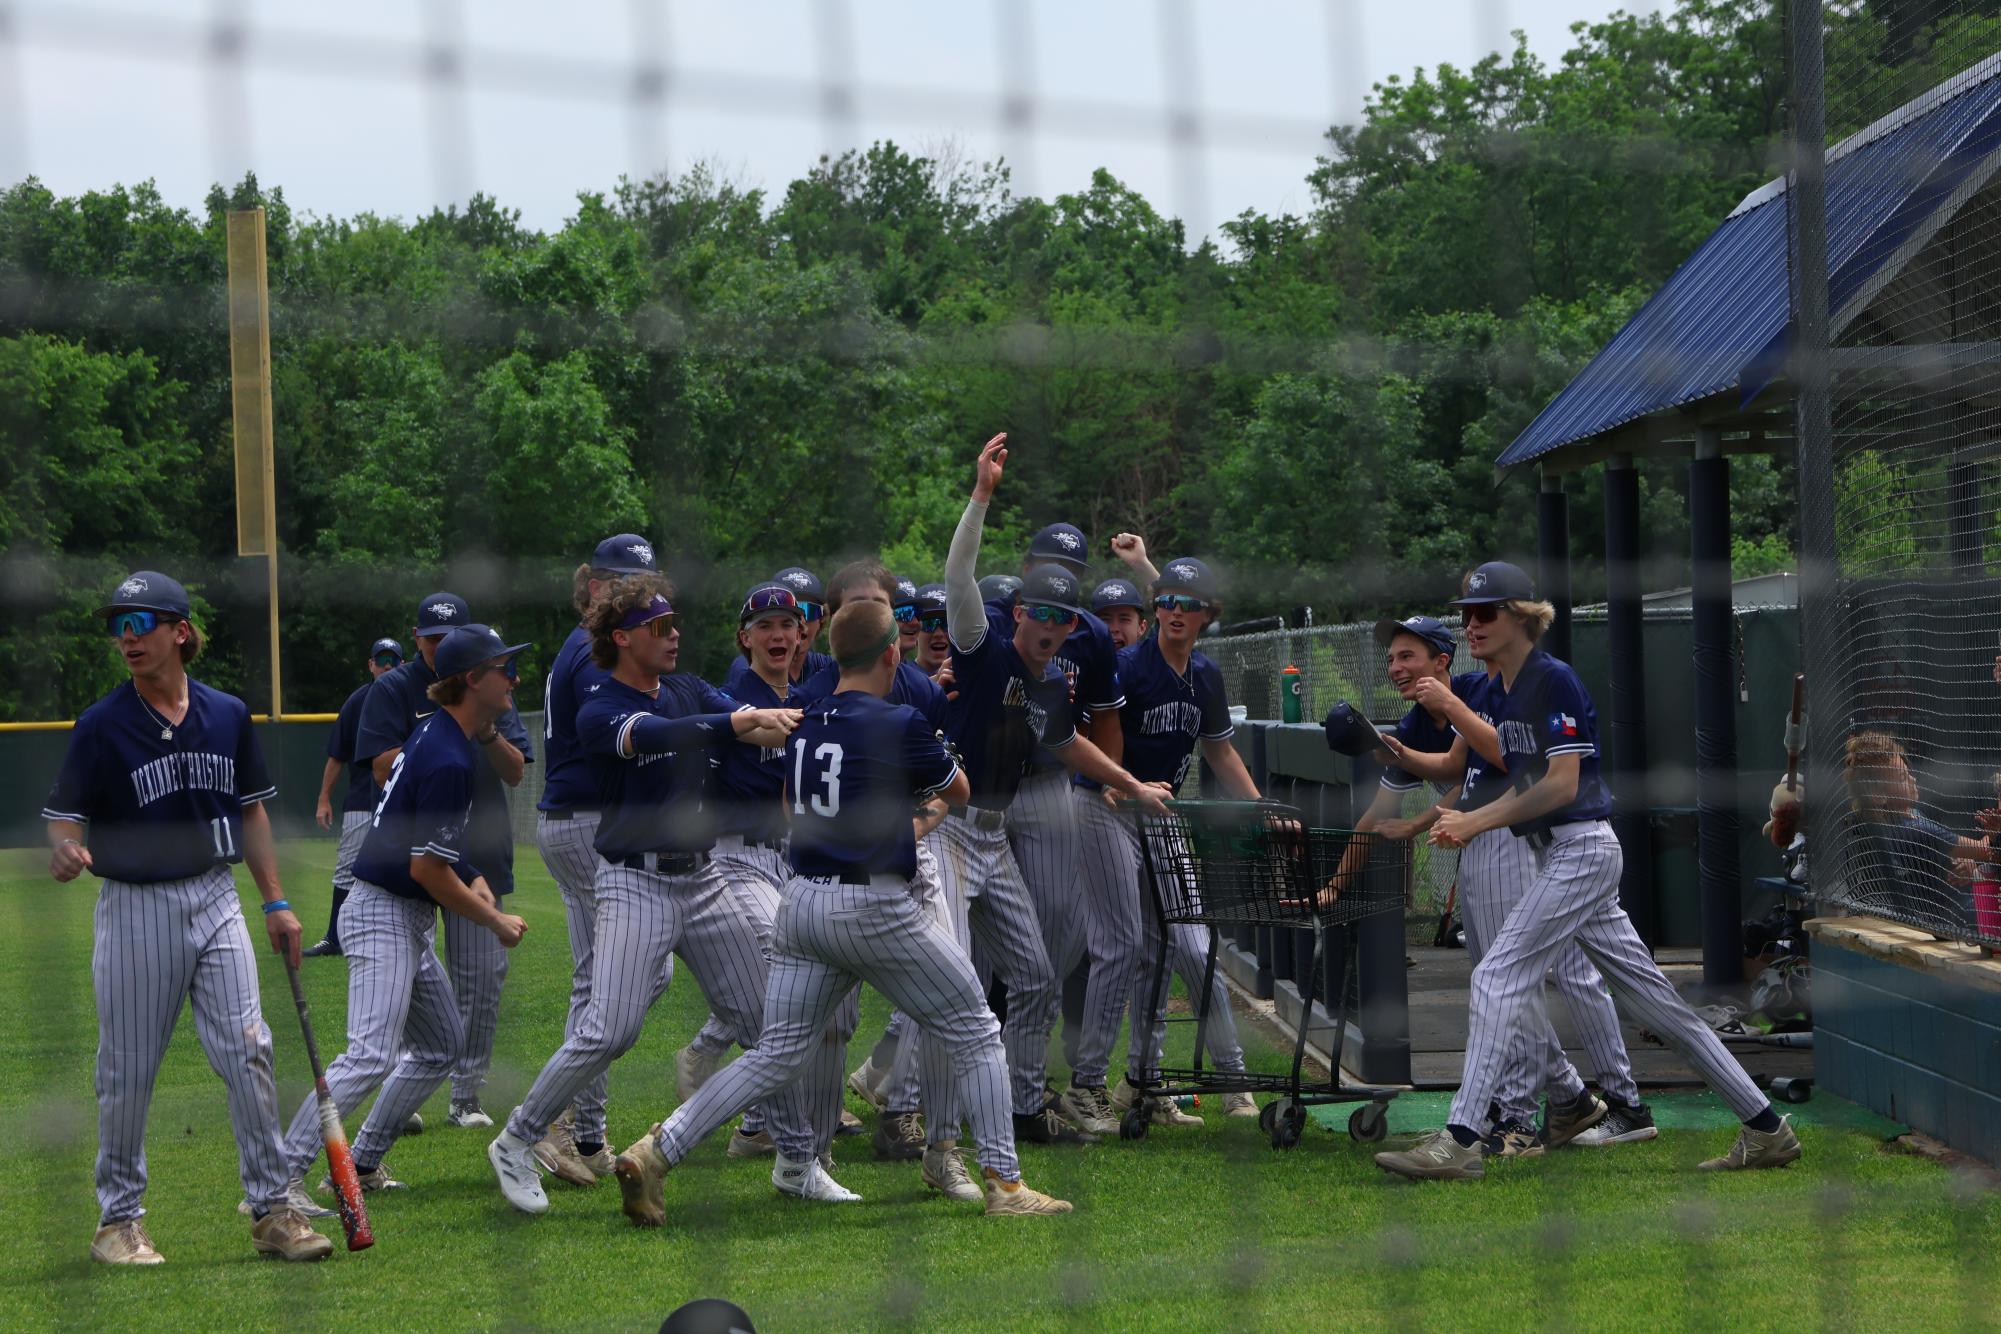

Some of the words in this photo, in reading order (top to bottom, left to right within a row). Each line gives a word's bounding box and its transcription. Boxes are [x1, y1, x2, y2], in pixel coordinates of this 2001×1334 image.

[130, 752, 184, 808] MCKINNEY
[794, 737, 844, 818] 13
[211, 816, 236, 858] 11
